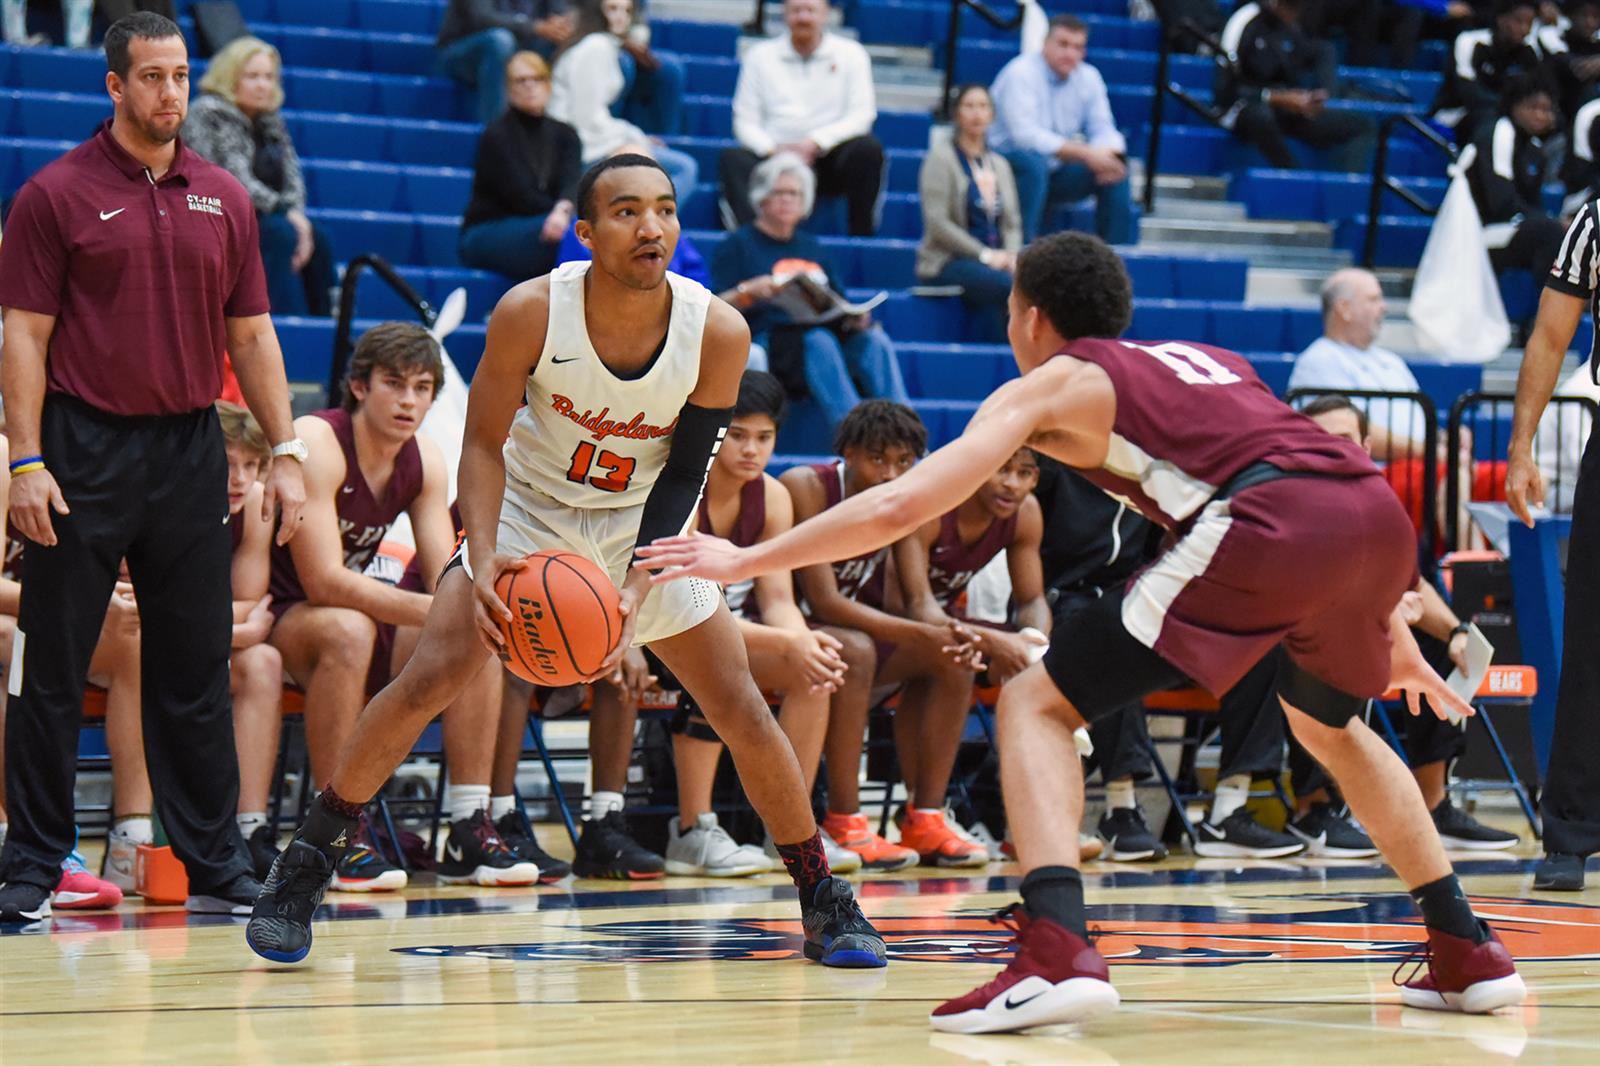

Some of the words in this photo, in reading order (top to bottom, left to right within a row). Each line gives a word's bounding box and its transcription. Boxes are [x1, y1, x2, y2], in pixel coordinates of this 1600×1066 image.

[186, 194, 222, 207] CY-FAIR
[566, 440, 637, 493] 13
[518, 597, 558, 675] Baden
[1489, 671, 1523, 692] BEARS
